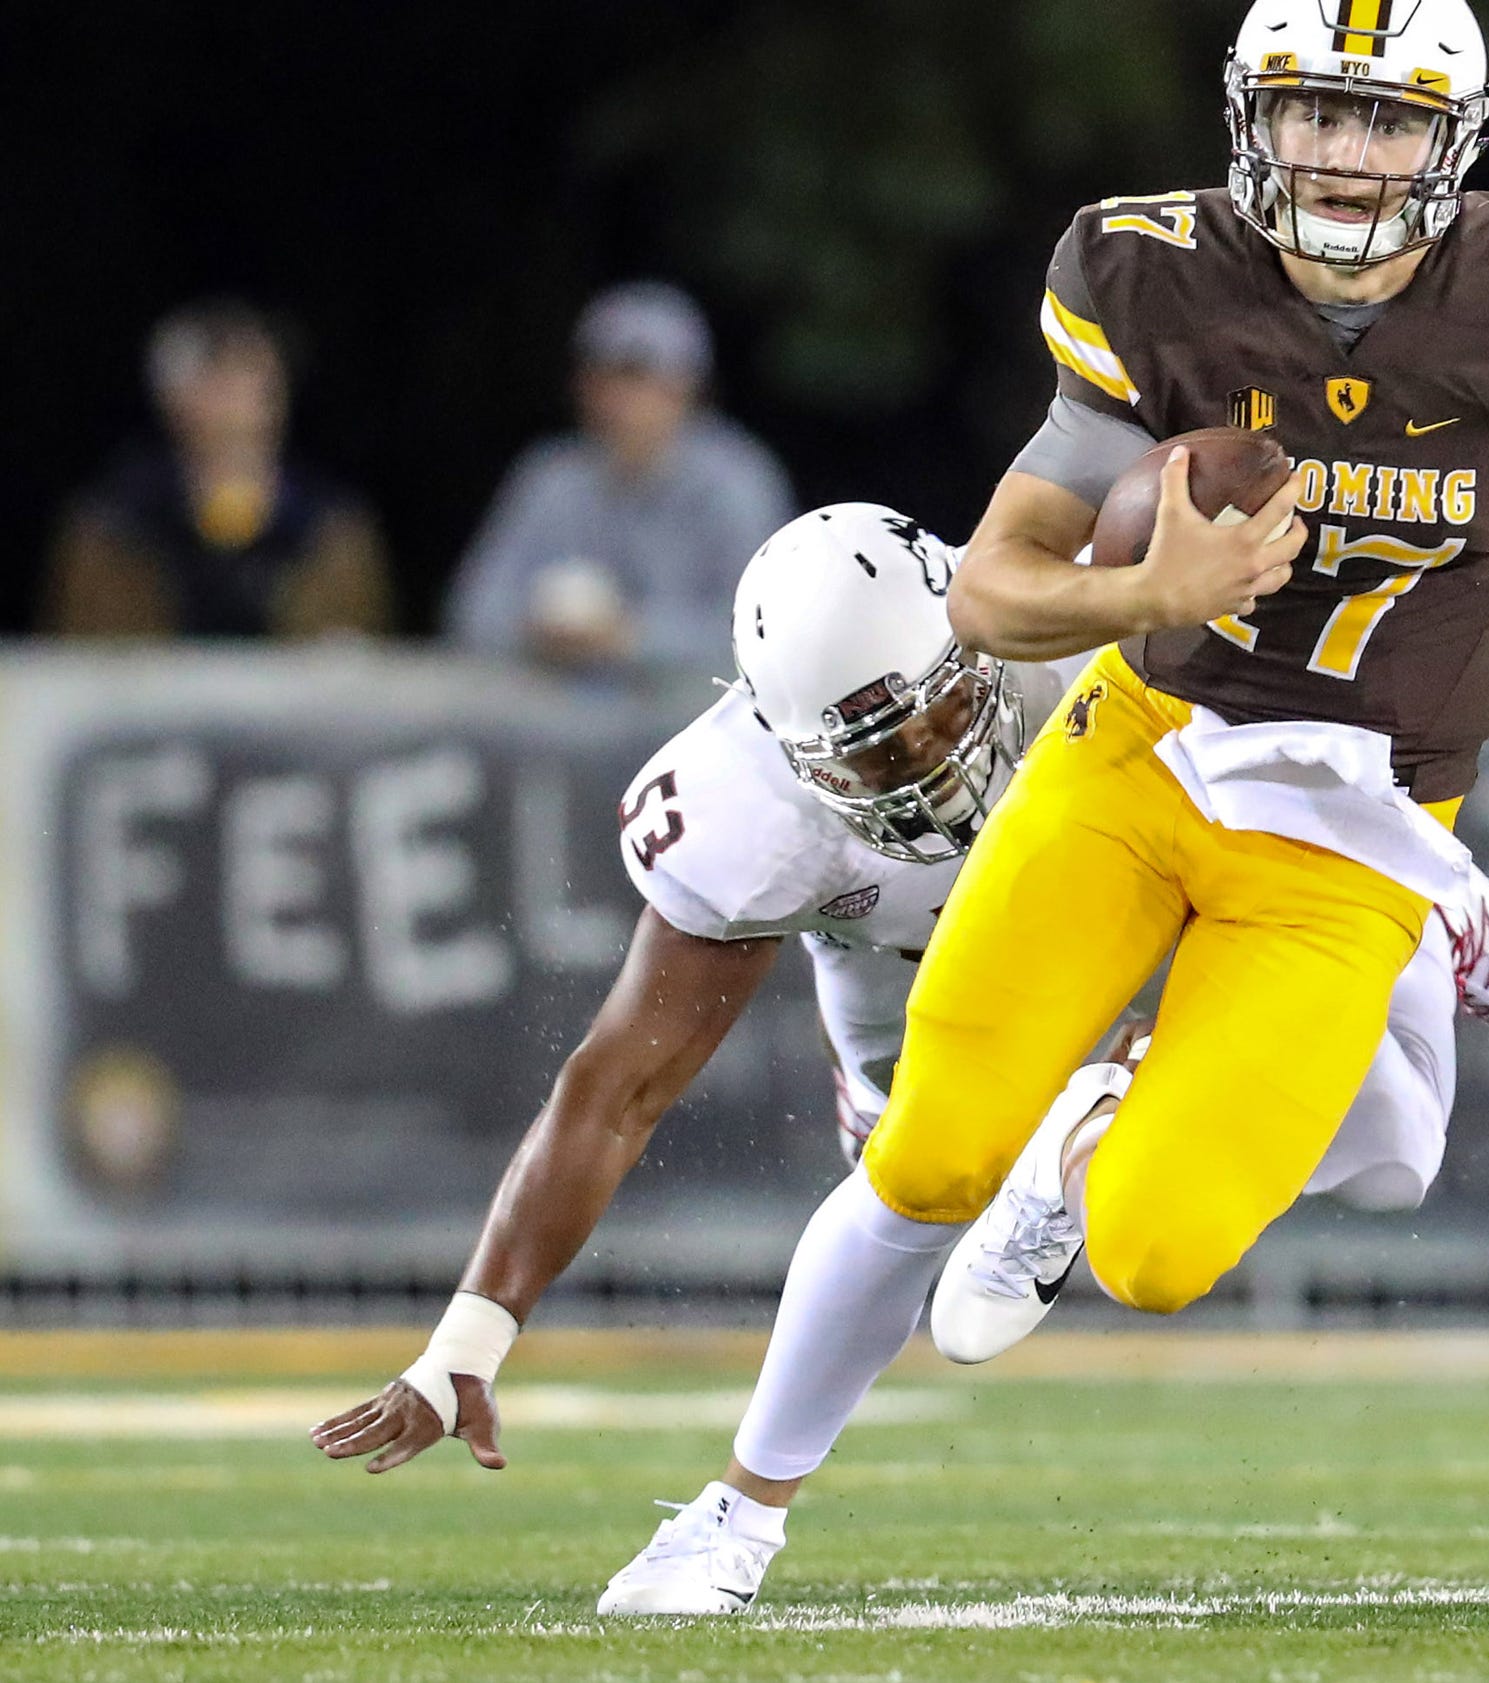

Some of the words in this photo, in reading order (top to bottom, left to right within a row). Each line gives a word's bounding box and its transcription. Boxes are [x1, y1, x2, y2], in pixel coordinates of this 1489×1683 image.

[1266, 55, 1292, 71] NIKE
[1341, 60, 1370, 77] WYO
[1100, 190, 1197, 250] 17
[1323, 242, 1359, 252] Riddell
[1286, 456, 1476, 525] OMING
[1206, 523, 1467, 681] 7
[812, 768, 852, 792] ddell
[617, 769, 686, 872] 53
